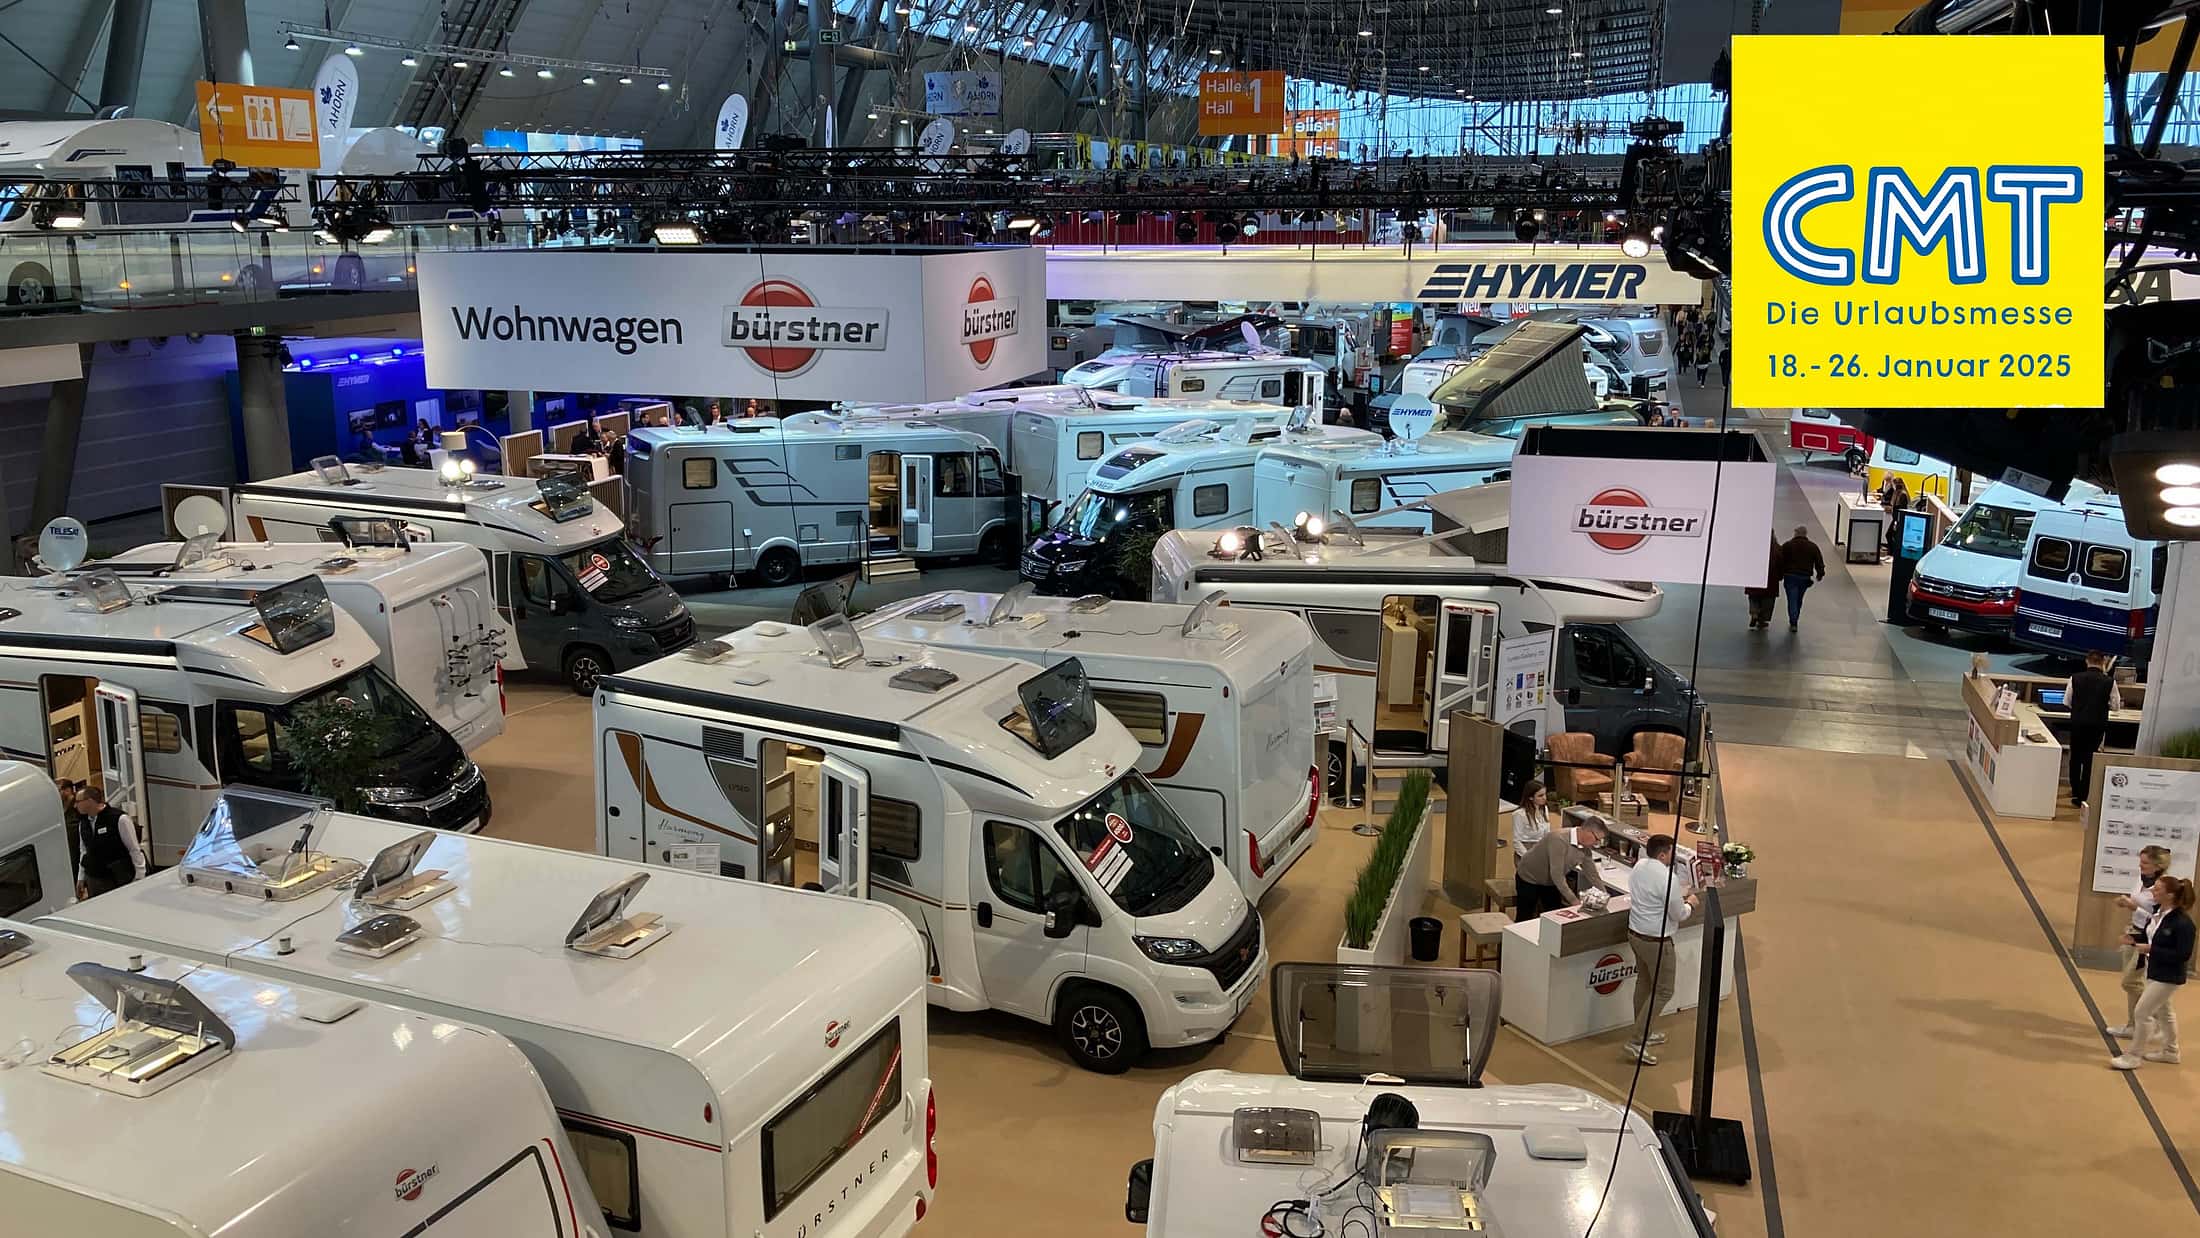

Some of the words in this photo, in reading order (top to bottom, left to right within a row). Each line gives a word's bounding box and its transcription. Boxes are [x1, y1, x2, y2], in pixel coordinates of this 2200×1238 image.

[329, 80, 346, 129] AHORN
[1206, 79, 1243, 93] Halle
[1250, 78, 1263, 114] 1
[1206, 100, 1233, 115] Hall
[1460, 264, 1647, 299] HYMER
[452, 305, 683, 355] Wohnwagen
[730, 311, 880, 344] bürstner
[963, 308, 1017, 337] bürstner
[1398, 408, 1433, 417] HYMER
[1578, 508, 1698, 532] bürstner
[394, 1164, 436, 1198] bürstner
